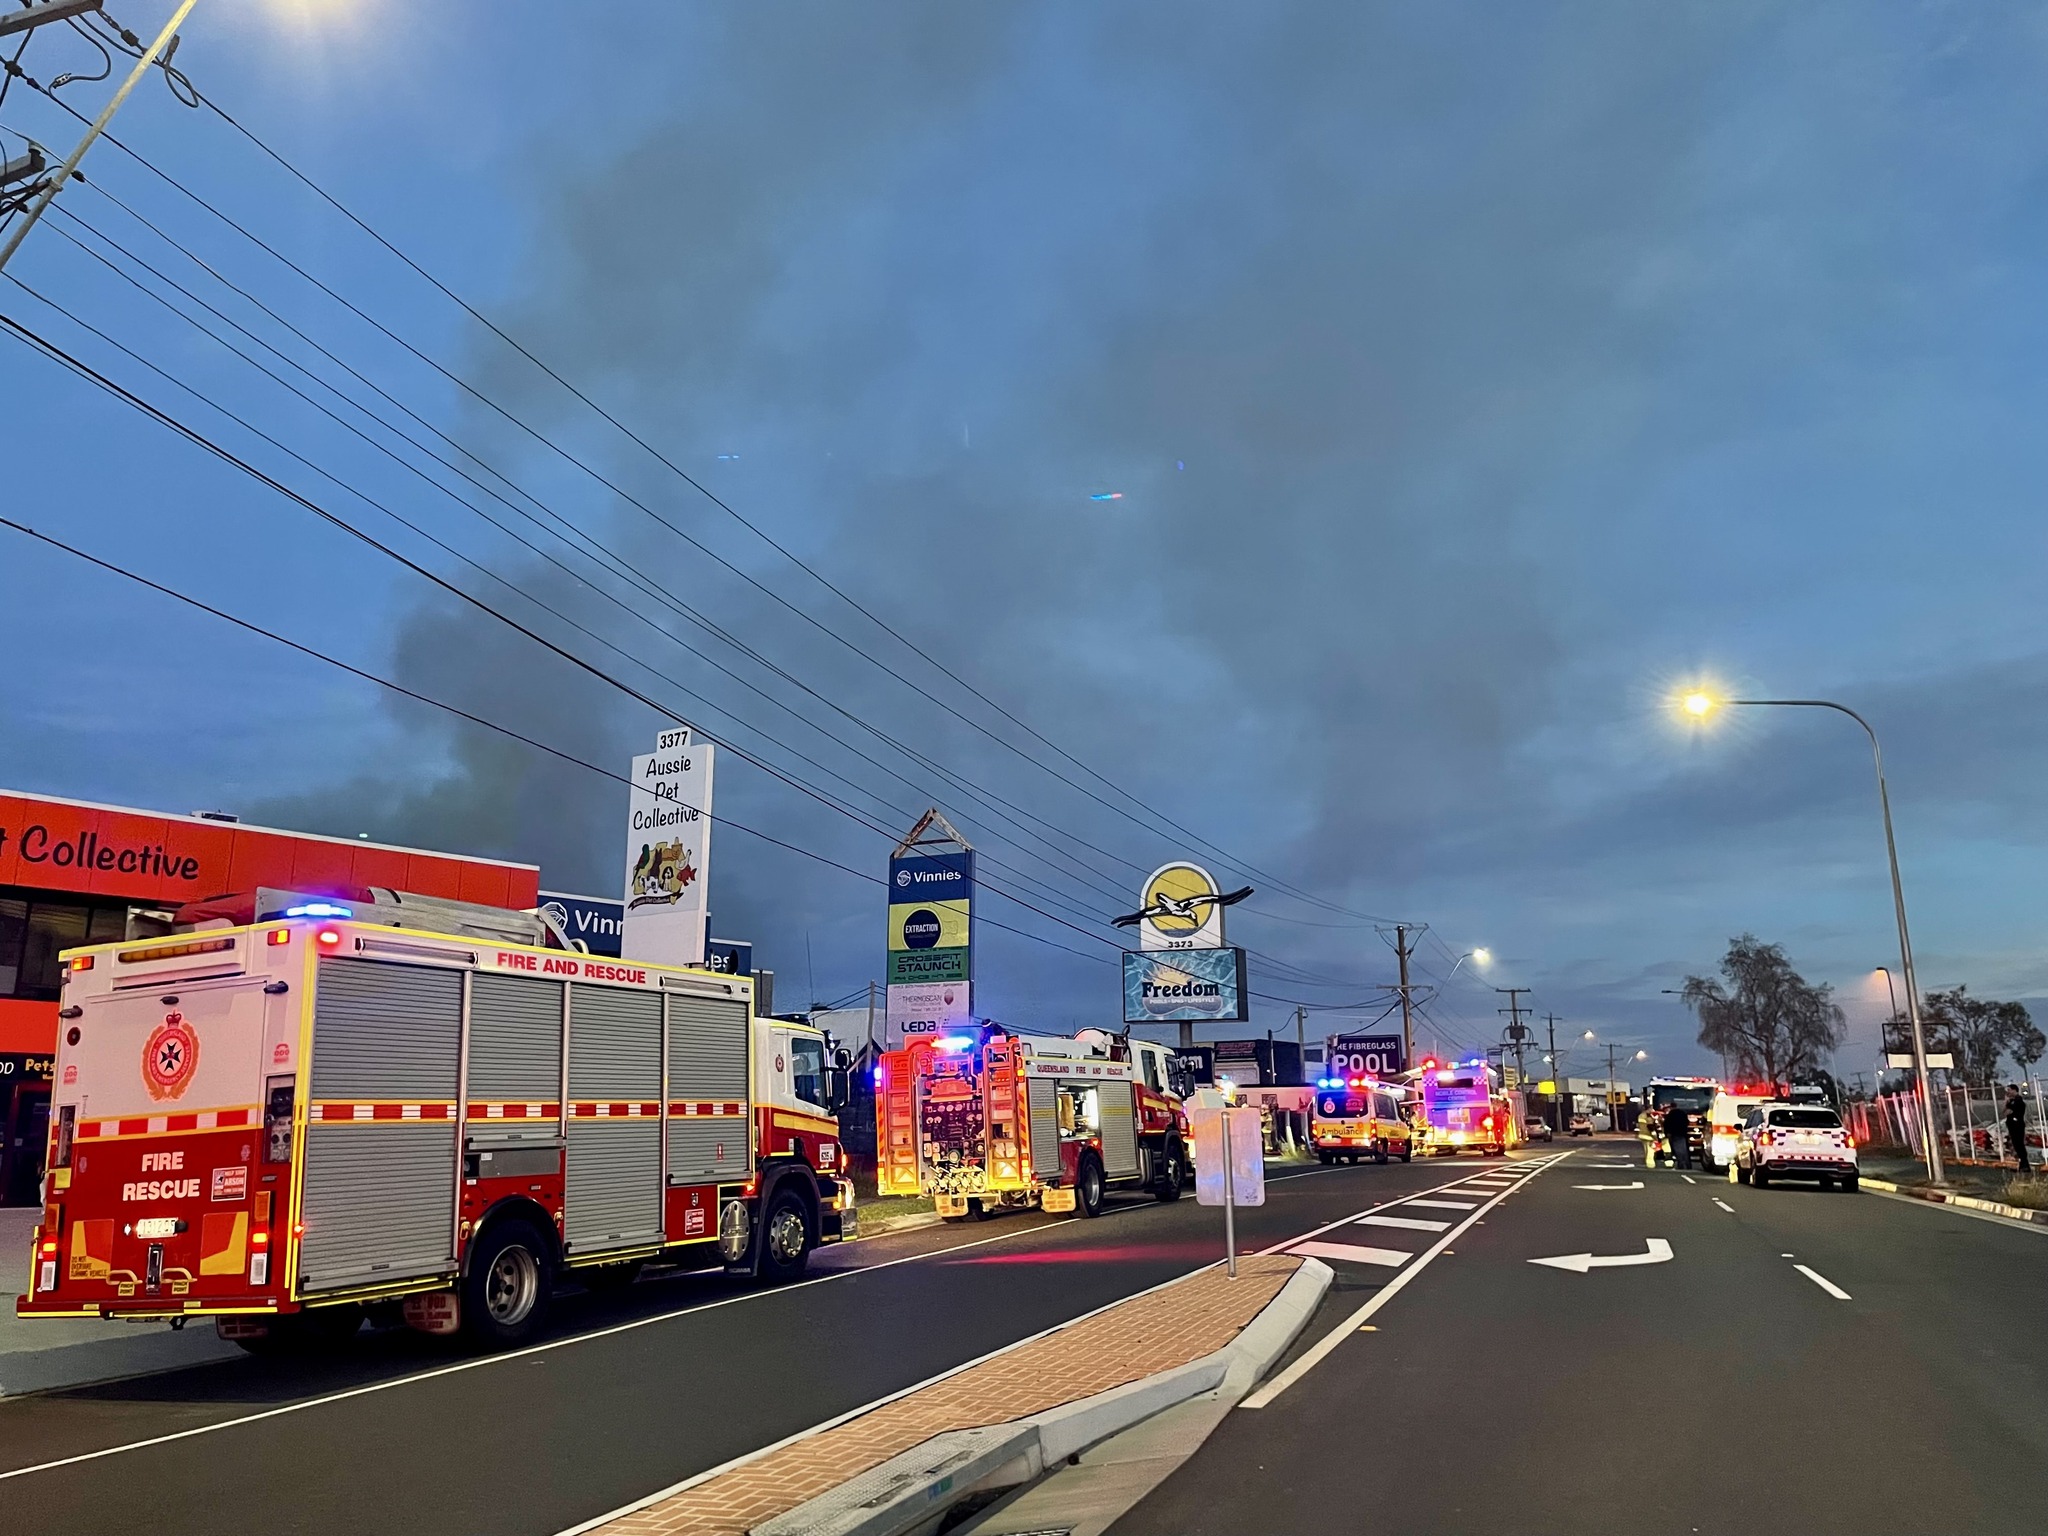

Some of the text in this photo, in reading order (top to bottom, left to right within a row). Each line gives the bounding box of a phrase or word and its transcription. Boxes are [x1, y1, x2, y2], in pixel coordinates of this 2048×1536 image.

[660, 731, 688, 750] 3377
[646, 755, 691, 778] Aussie
[655, 782, 679, 801] Pet
[633, 807, 699, 830] Collective
[20, 824, 199, 880] Collective
[914, 870, 962, 883] Vinnies
[905, 923, 939, 934] EXTRACTION
[1168, 940, 1193, 949] 3373
[897, 961, 961, 973] STAUNCH
[898, 953, 961, 964] CROSSFIT
[497, 952, 646, 985] FIRE AND RESCUE
[1142, 980, 1220, 998] Freedom
[1349, 1042, 1396, 1051] FIBREGLASS
[1037, 1065, 1124, 1076] QUEENSLAND FIRE AND RESCUE
[1332, 1053, 1397, 1075] POOL
[1321, 1128, 1365, 1136] Ambulance
[141, 1151, 185, 1172] FIRE
[122, 1178, 201, 1201] RESCUE
